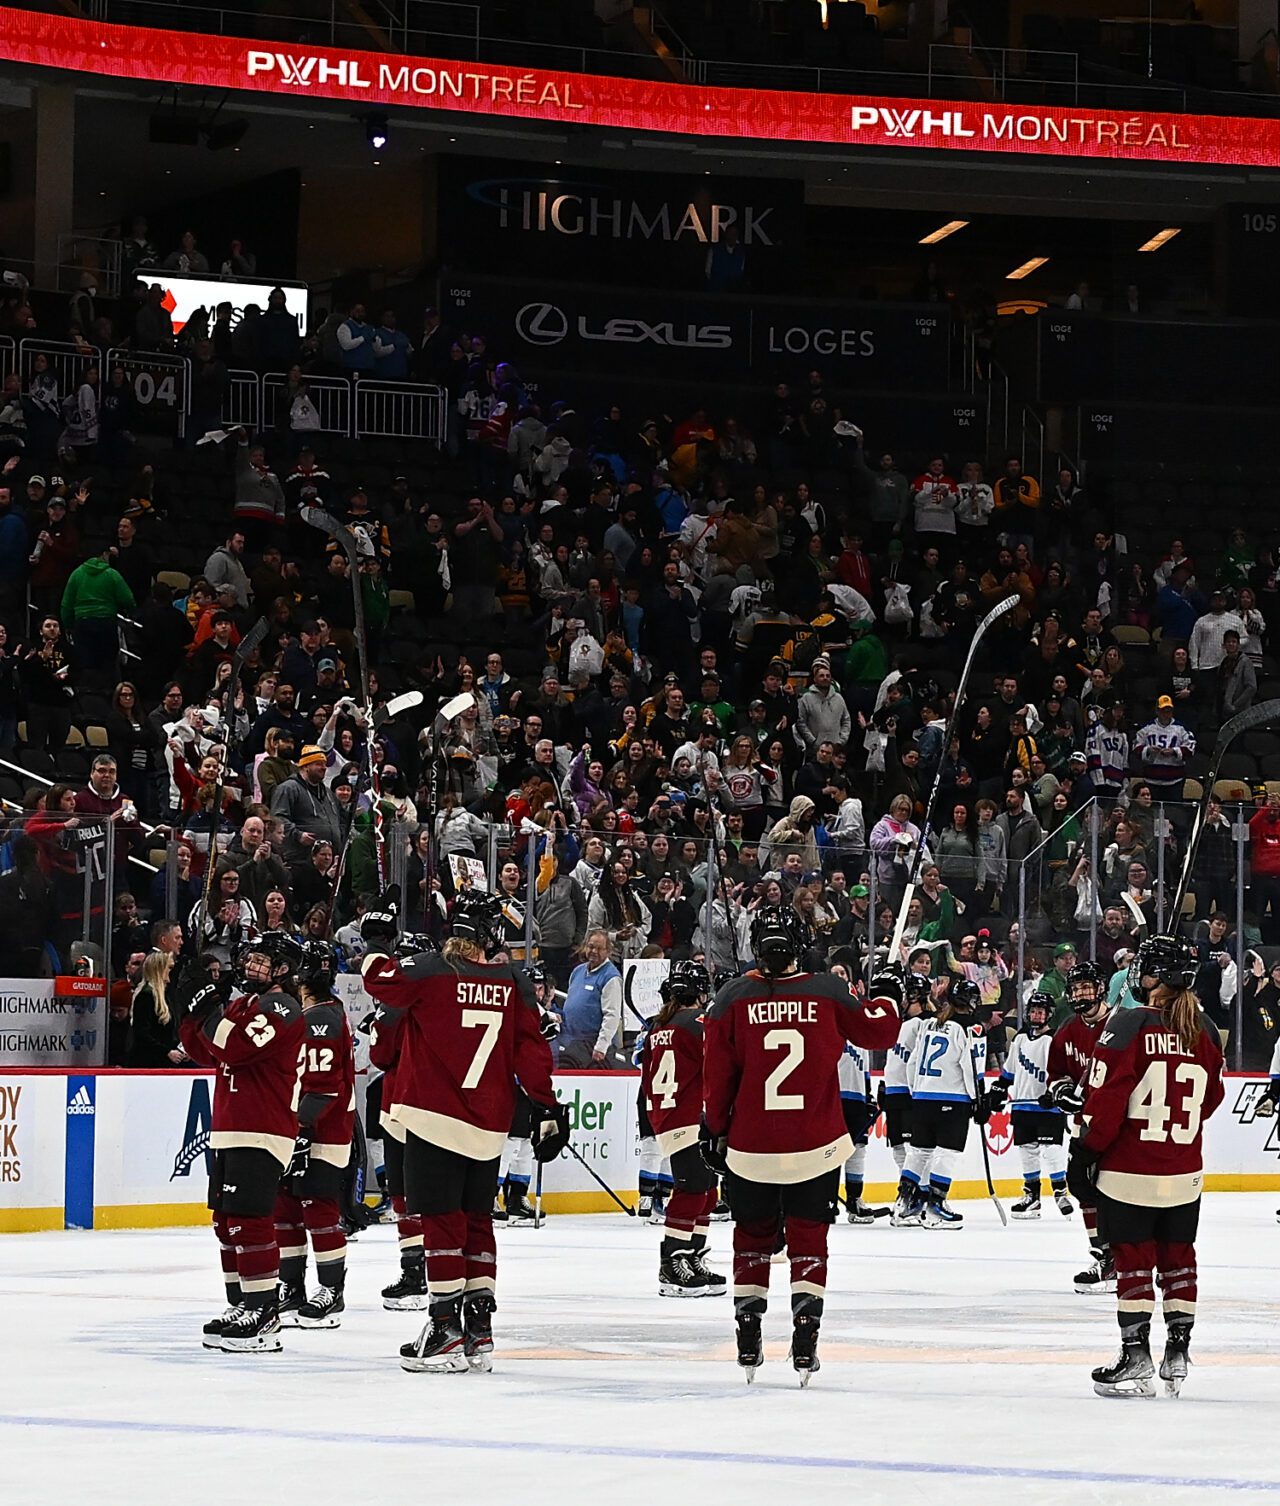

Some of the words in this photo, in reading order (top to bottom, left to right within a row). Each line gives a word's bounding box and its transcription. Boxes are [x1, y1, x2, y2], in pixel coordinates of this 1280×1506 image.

[246, 49, 372, 88] PWHL
[379, 64, 585, 110] MONTRÉAL
[851, 105, 976, 138] PWHL
[983, 113, 1191, 149] MONTRÉAL
[499, 188, 776, 247] HIGHMARK
[1241, 212, 1278, 233] 105
[577, 315, 734, 350] LEXUS
[768, 327, 877, 358] LOGES
[1146, 733, 1177, 748] USA
[71, 982, 104, 992] GATORADE
[457, 982, 513, 1007] STACEY
[747, 1000, 819, 1024] KEOPPLE
[243, 1013, 277, 1049] 23
[460, 1009, 504, 1089] 7
[1144, 1032, 1196, 1058] O'NEILL
[307, 1046, 335, 1073] 12
[763, 1028, 805, 1111] 2
[918, 1034, 950, 1078] 12
[67, 1104, 95, 1116] adidas
[1127, 1060, 1209, 1146] 43
